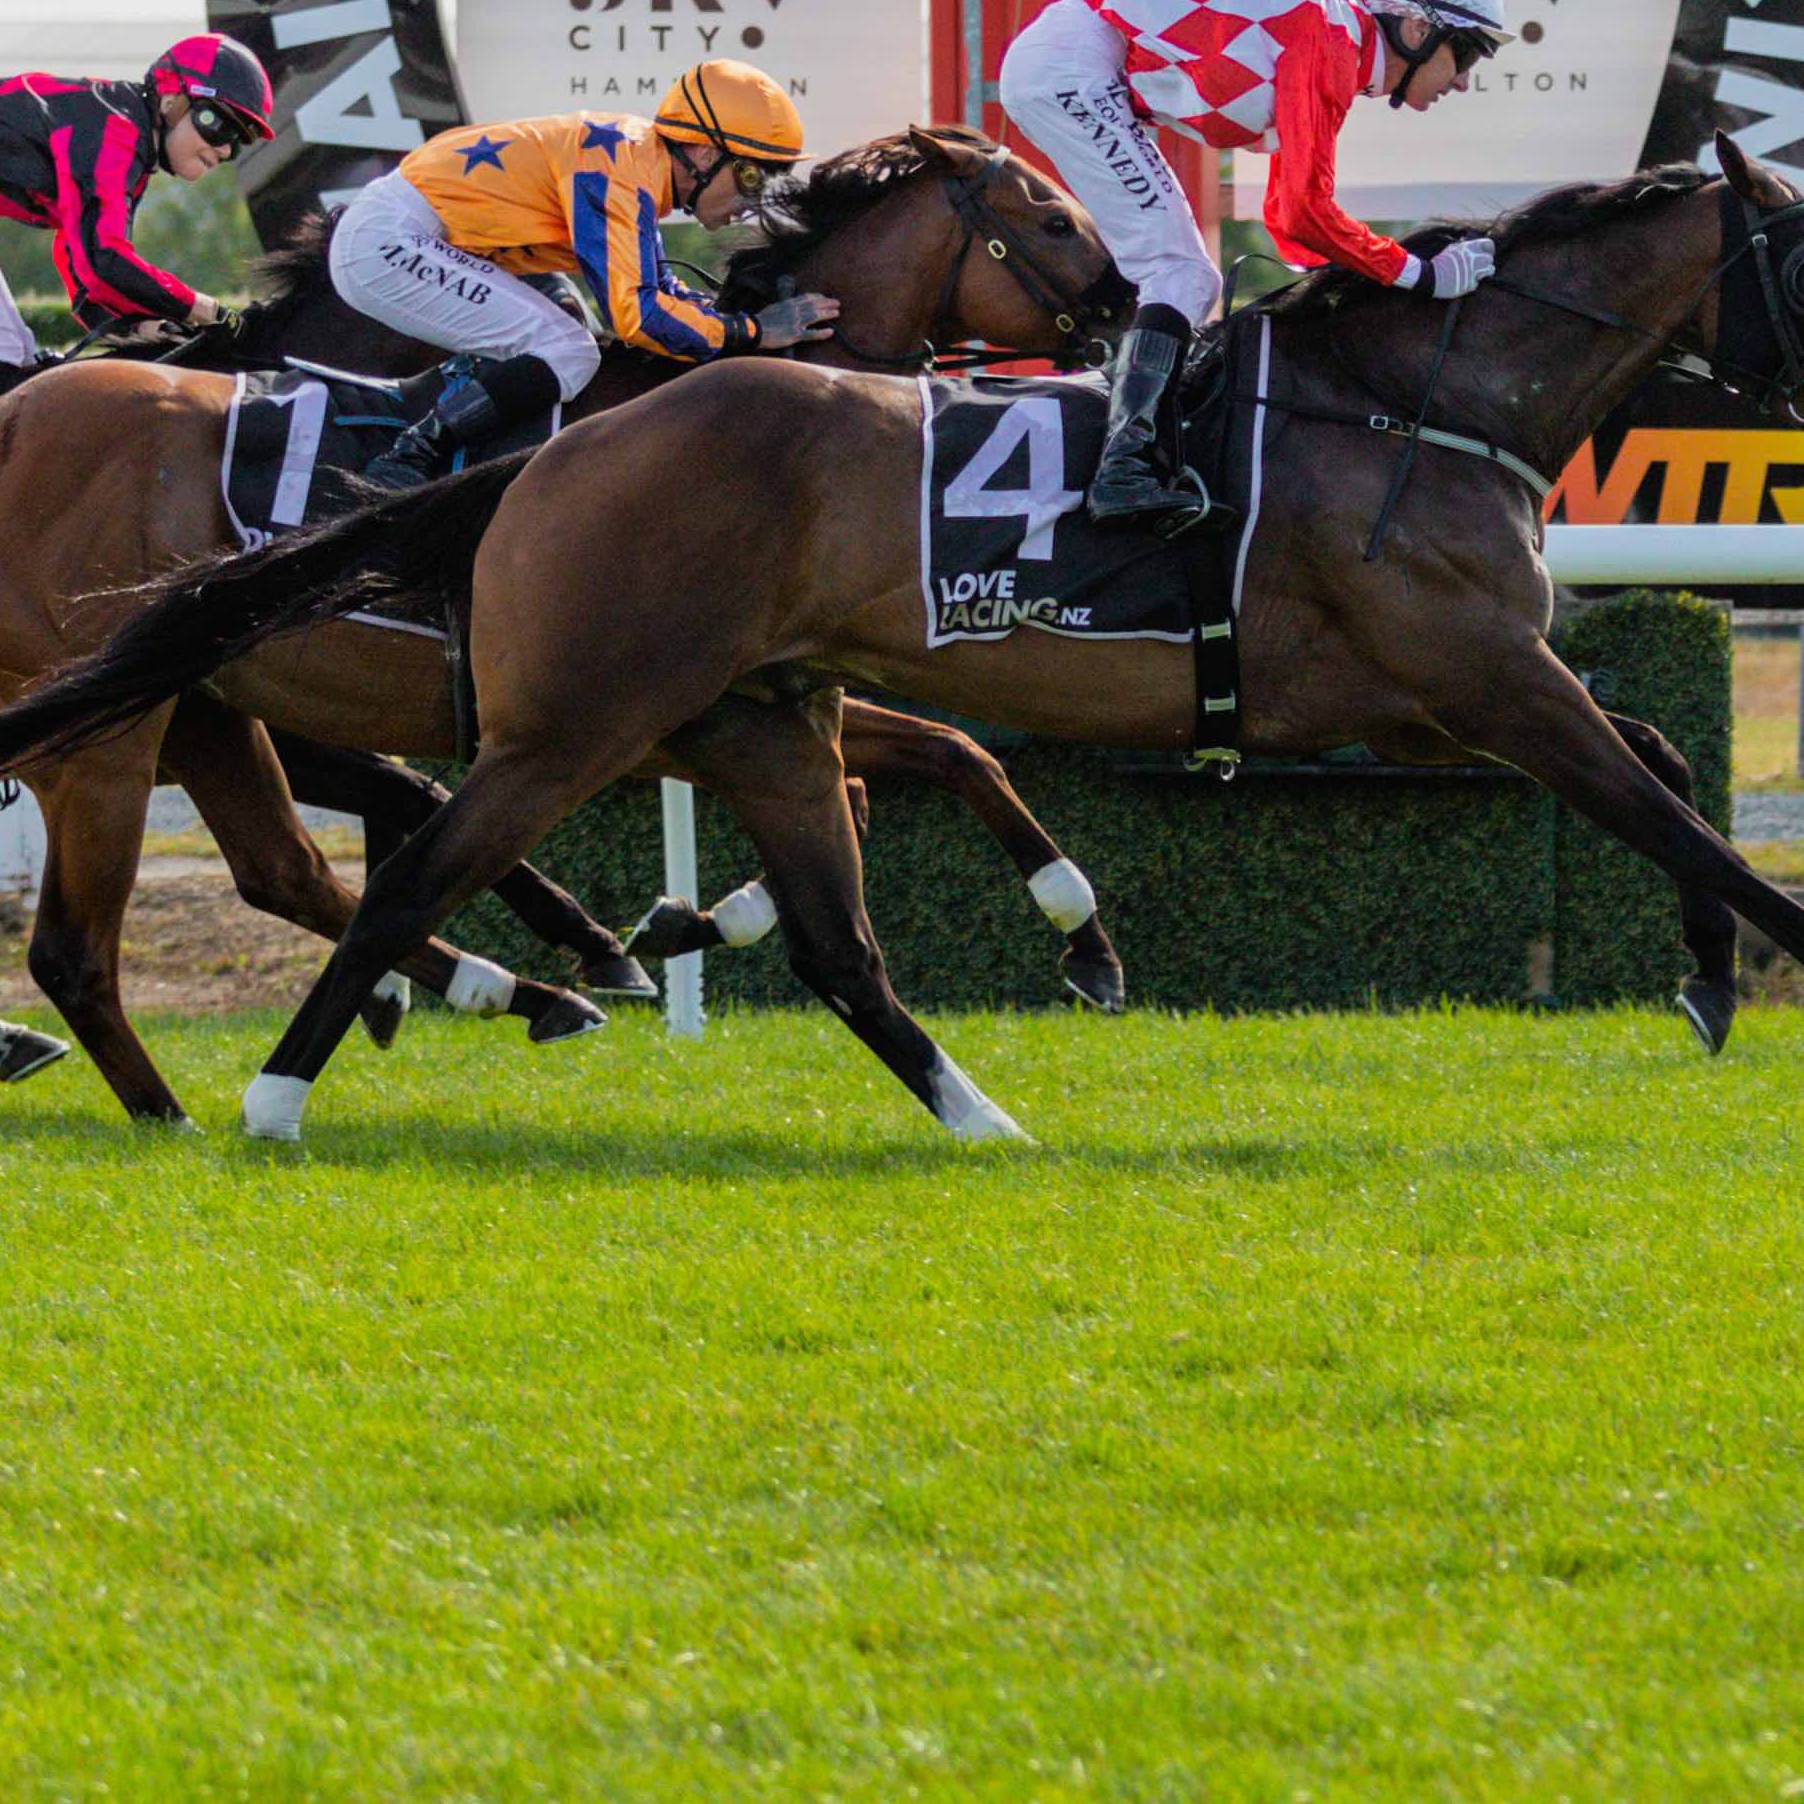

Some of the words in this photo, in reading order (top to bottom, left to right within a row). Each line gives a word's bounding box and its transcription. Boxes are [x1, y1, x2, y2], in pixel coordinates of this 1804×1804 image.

[569, 25, 721, 52] CITY
[570, 77, 808, 96] HAMN
[1474, 73, 1588, 91] LTON
[1055, 89, 1169, 211] KENNEDY
[265, 381, 329, 527] 1
[943, 397, 1084, 561] 4
[940, 570, 1016, 604] LOVE
